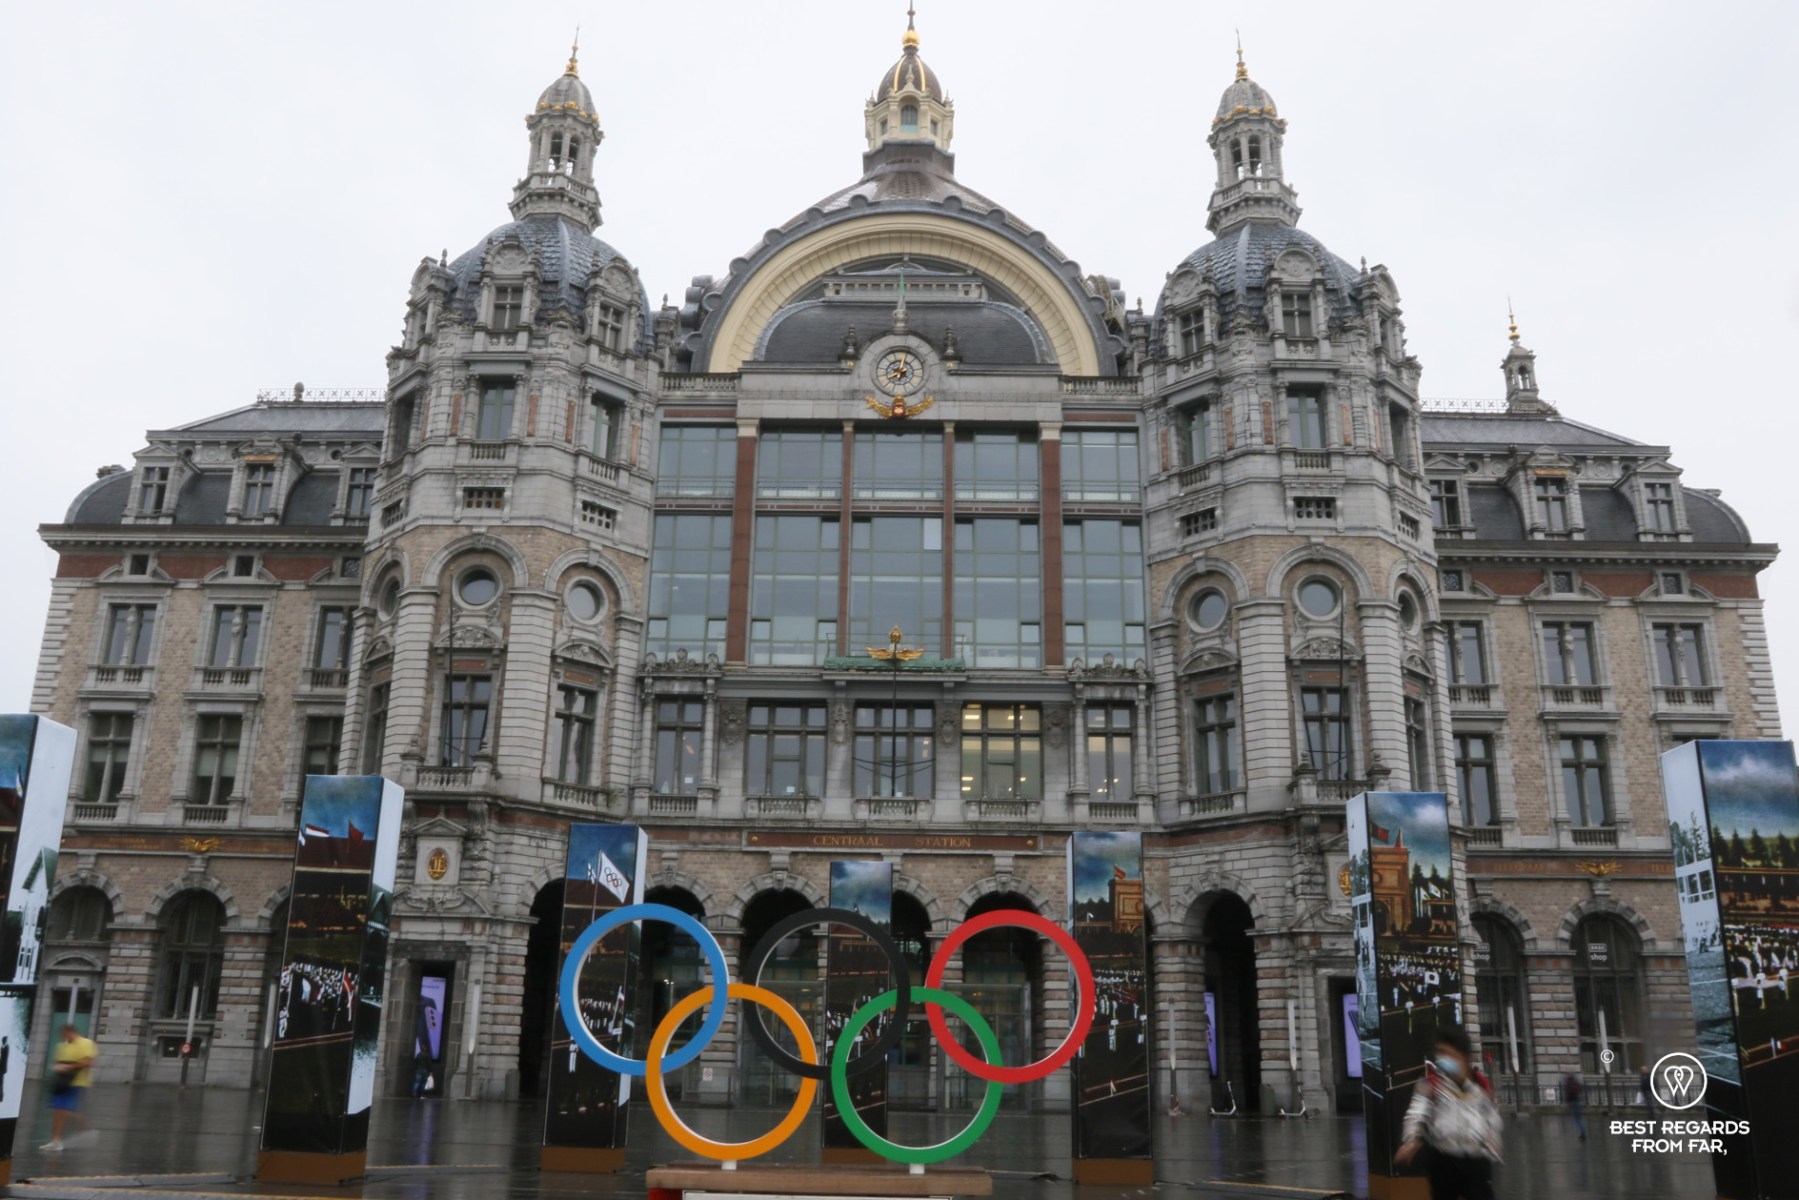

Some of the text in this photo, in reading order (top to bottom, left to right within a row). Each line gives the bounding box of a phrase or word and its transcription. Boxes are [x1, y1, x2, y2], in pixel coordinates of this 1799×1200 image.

[813, 836, 971, 847] CENTRAAL STATION
[1590, 952, 1607, 962] shop
